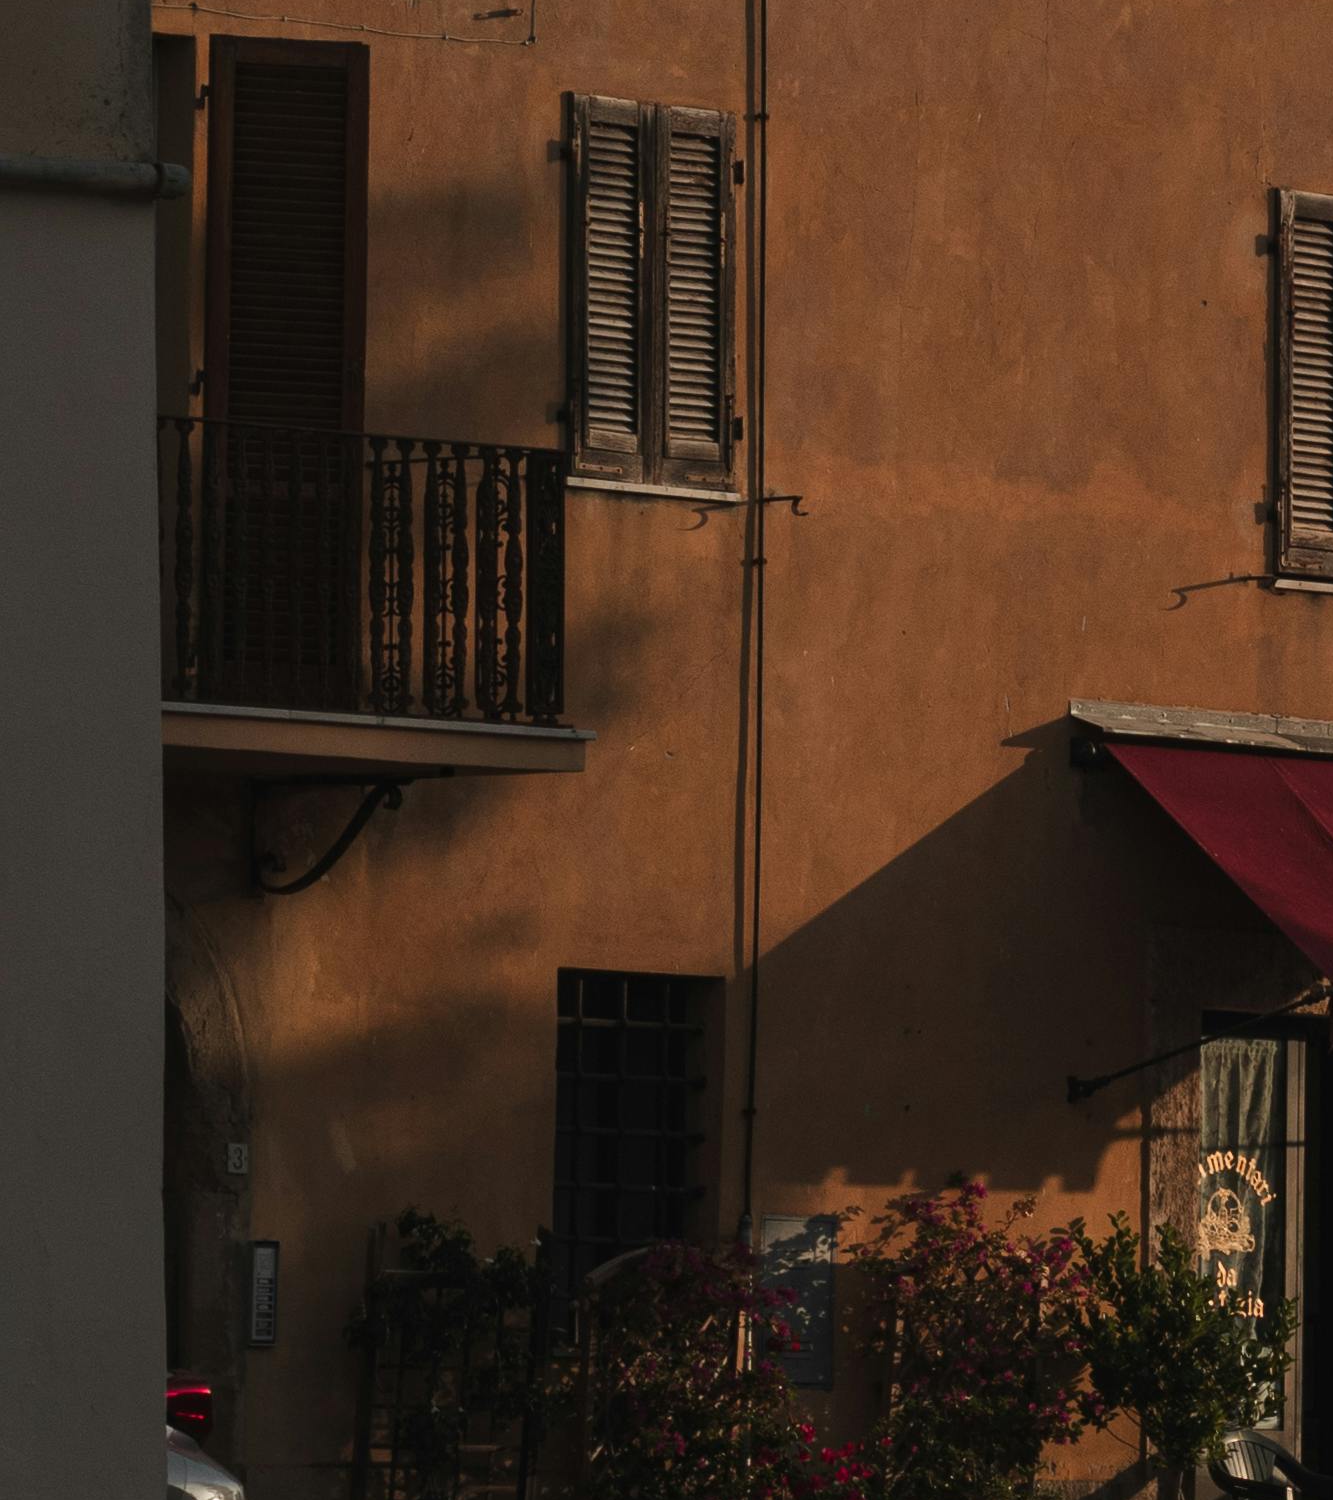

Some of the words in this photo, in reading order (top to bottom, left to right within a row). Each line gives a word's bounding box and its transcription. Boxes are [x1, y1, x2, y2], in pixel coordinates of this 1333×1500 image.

[233, 1148, 243, 1169] 3
[1197, 1149, 1279, 1207] imentari
[1216, 1260, 1238, 1288] da
